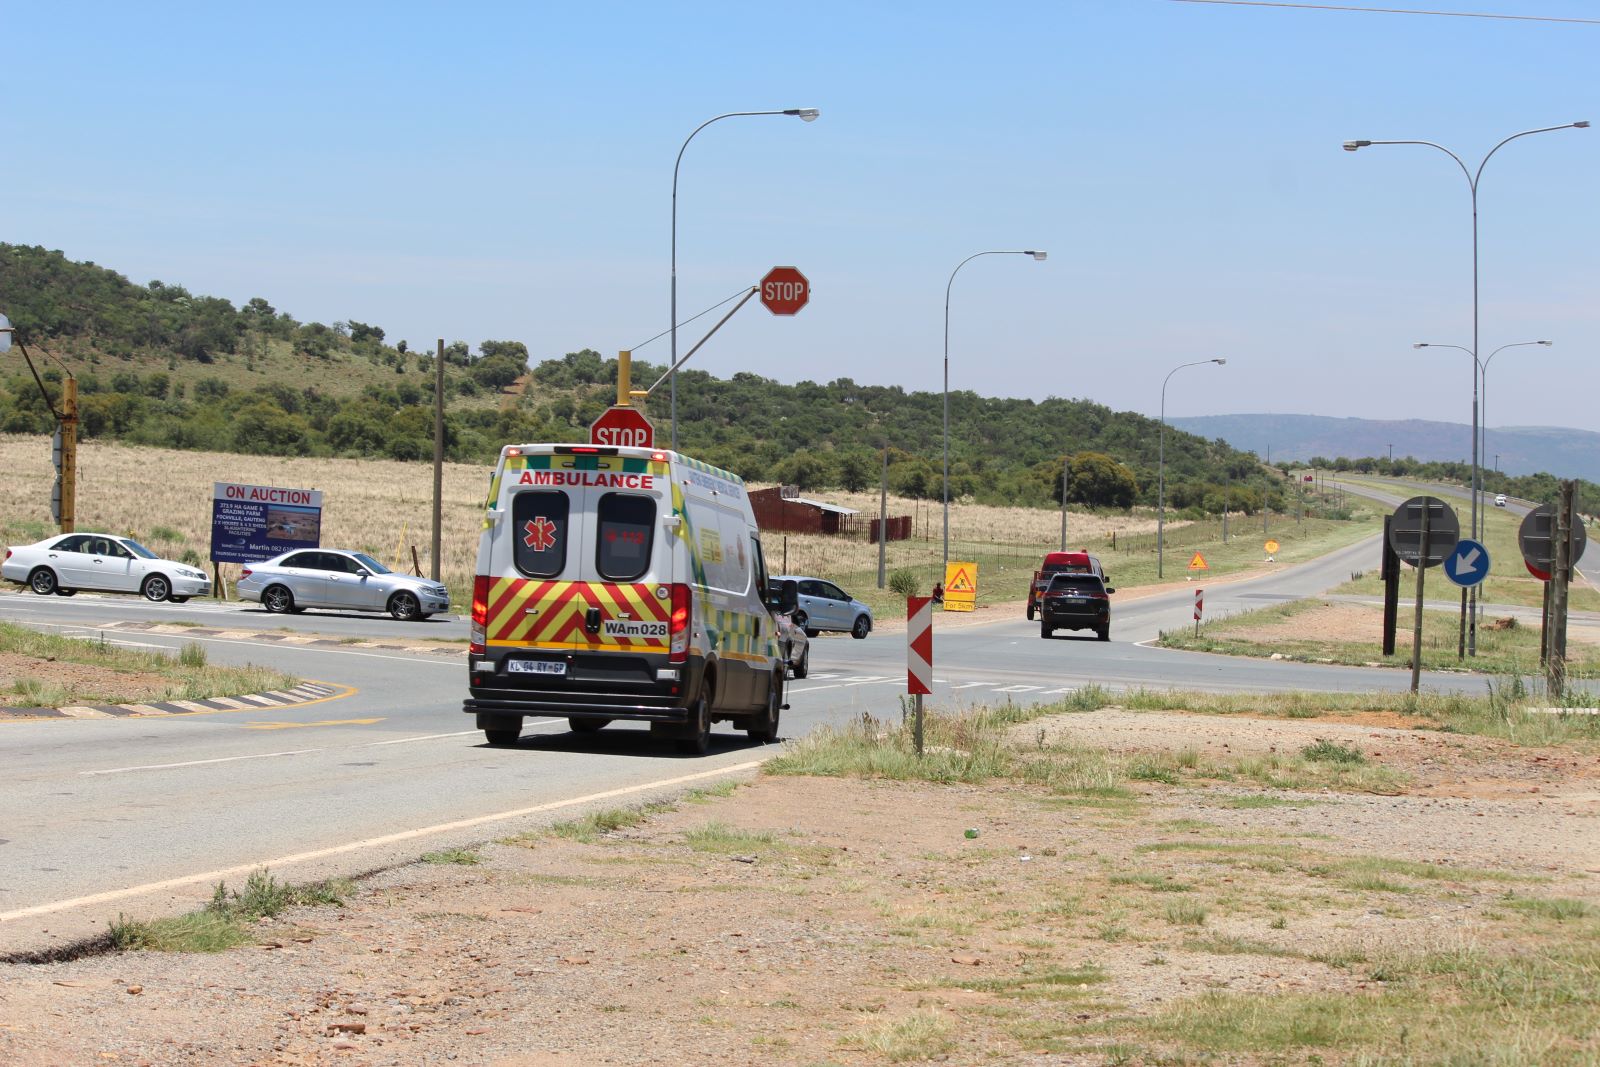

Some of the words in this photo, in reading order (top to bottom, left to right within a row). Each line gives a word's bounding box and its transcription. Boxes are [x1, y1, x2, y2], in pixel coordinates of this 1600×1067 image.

[765, 281, 804, 301] STOP
[597, 427, 647, 447] STOP
[518, 471, 654, 489] AMBULANCE
[226, 486, 245, 499] ON
[249, 488, 311, 504] AUCTION
[249, 543, 270, 551] Martin
[945, 601, 956, 609] For
